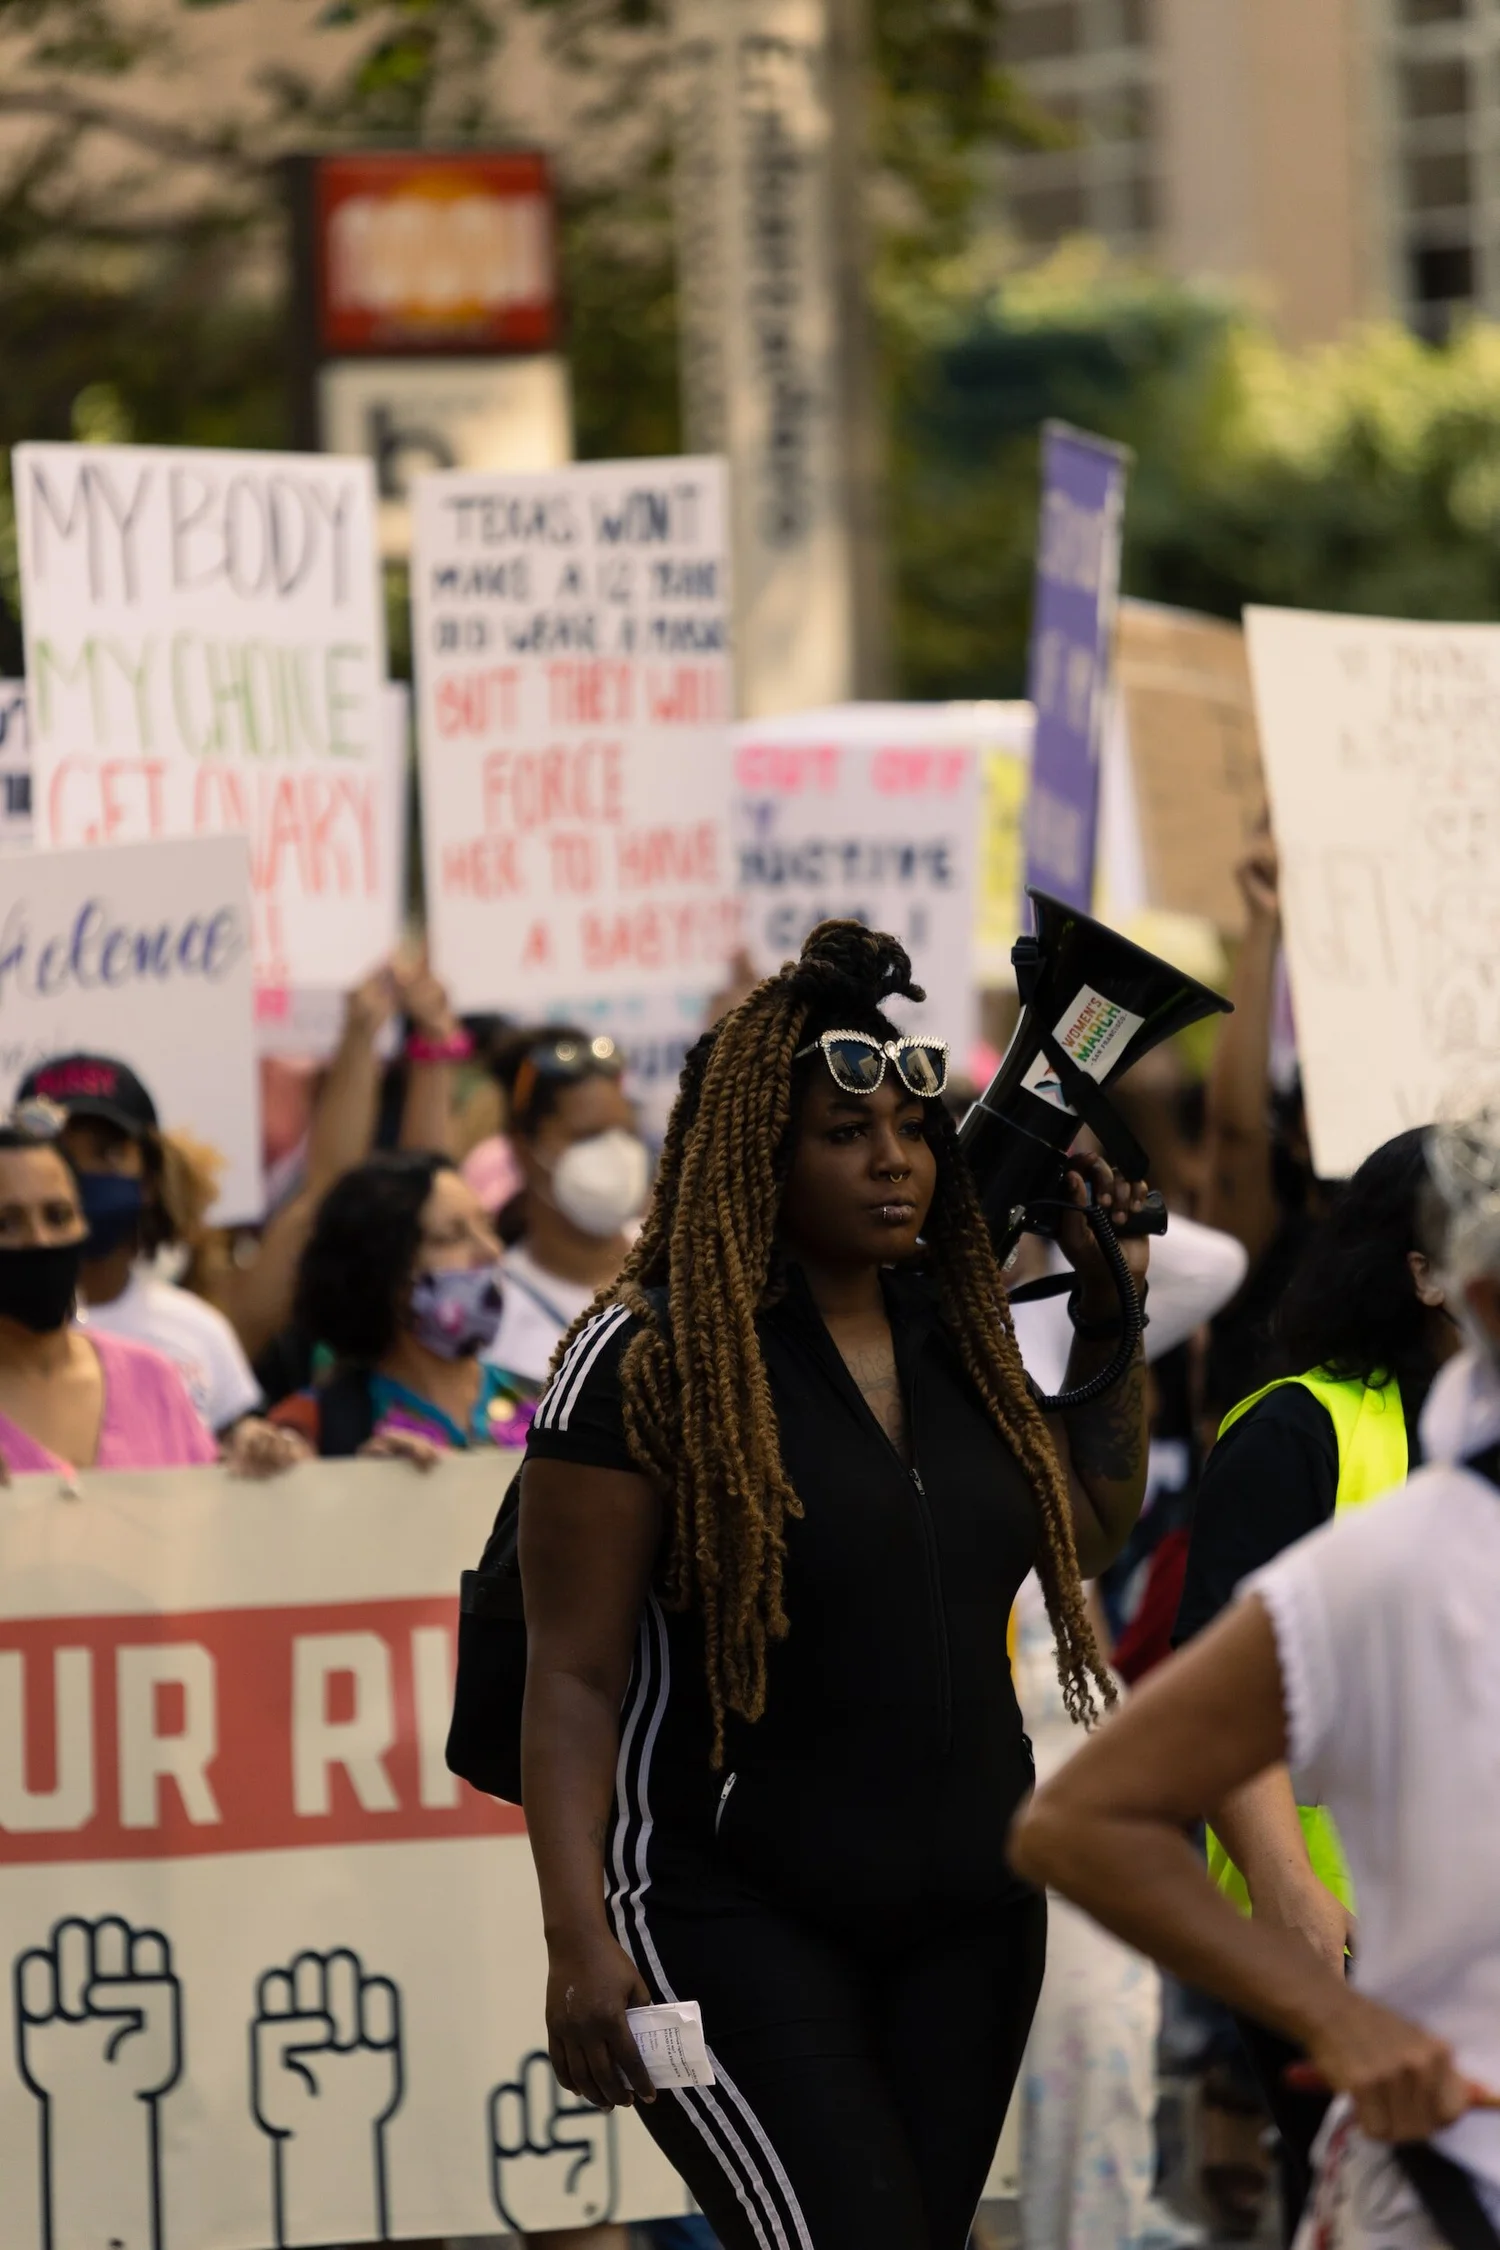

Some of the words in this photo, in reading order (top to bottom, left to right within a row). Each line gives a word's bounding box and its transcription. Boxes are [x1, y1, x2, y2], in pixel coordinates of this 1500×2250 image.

[31, 461, 153, 607] MY
[169, 466, 356, 608] BODY
[33, 633, 157, 755] MY
[171, 630, 367, 758] CHOICE
[435, 665, 520, 737] BUT
[545, 660, 634, 725] THEY
[481, 741, 625, 835] FORCE
[441, 838, 524, 900] HER
[548, 833, 598, 896] TO
[616, 821, 719, 890] HAVE
[1062, 997, 1103, 1050] WOMEN'S
[1072, 1002, 1121, 1063] MARCH
[1101, 1015, 1127, 1050] FRANCISCO
